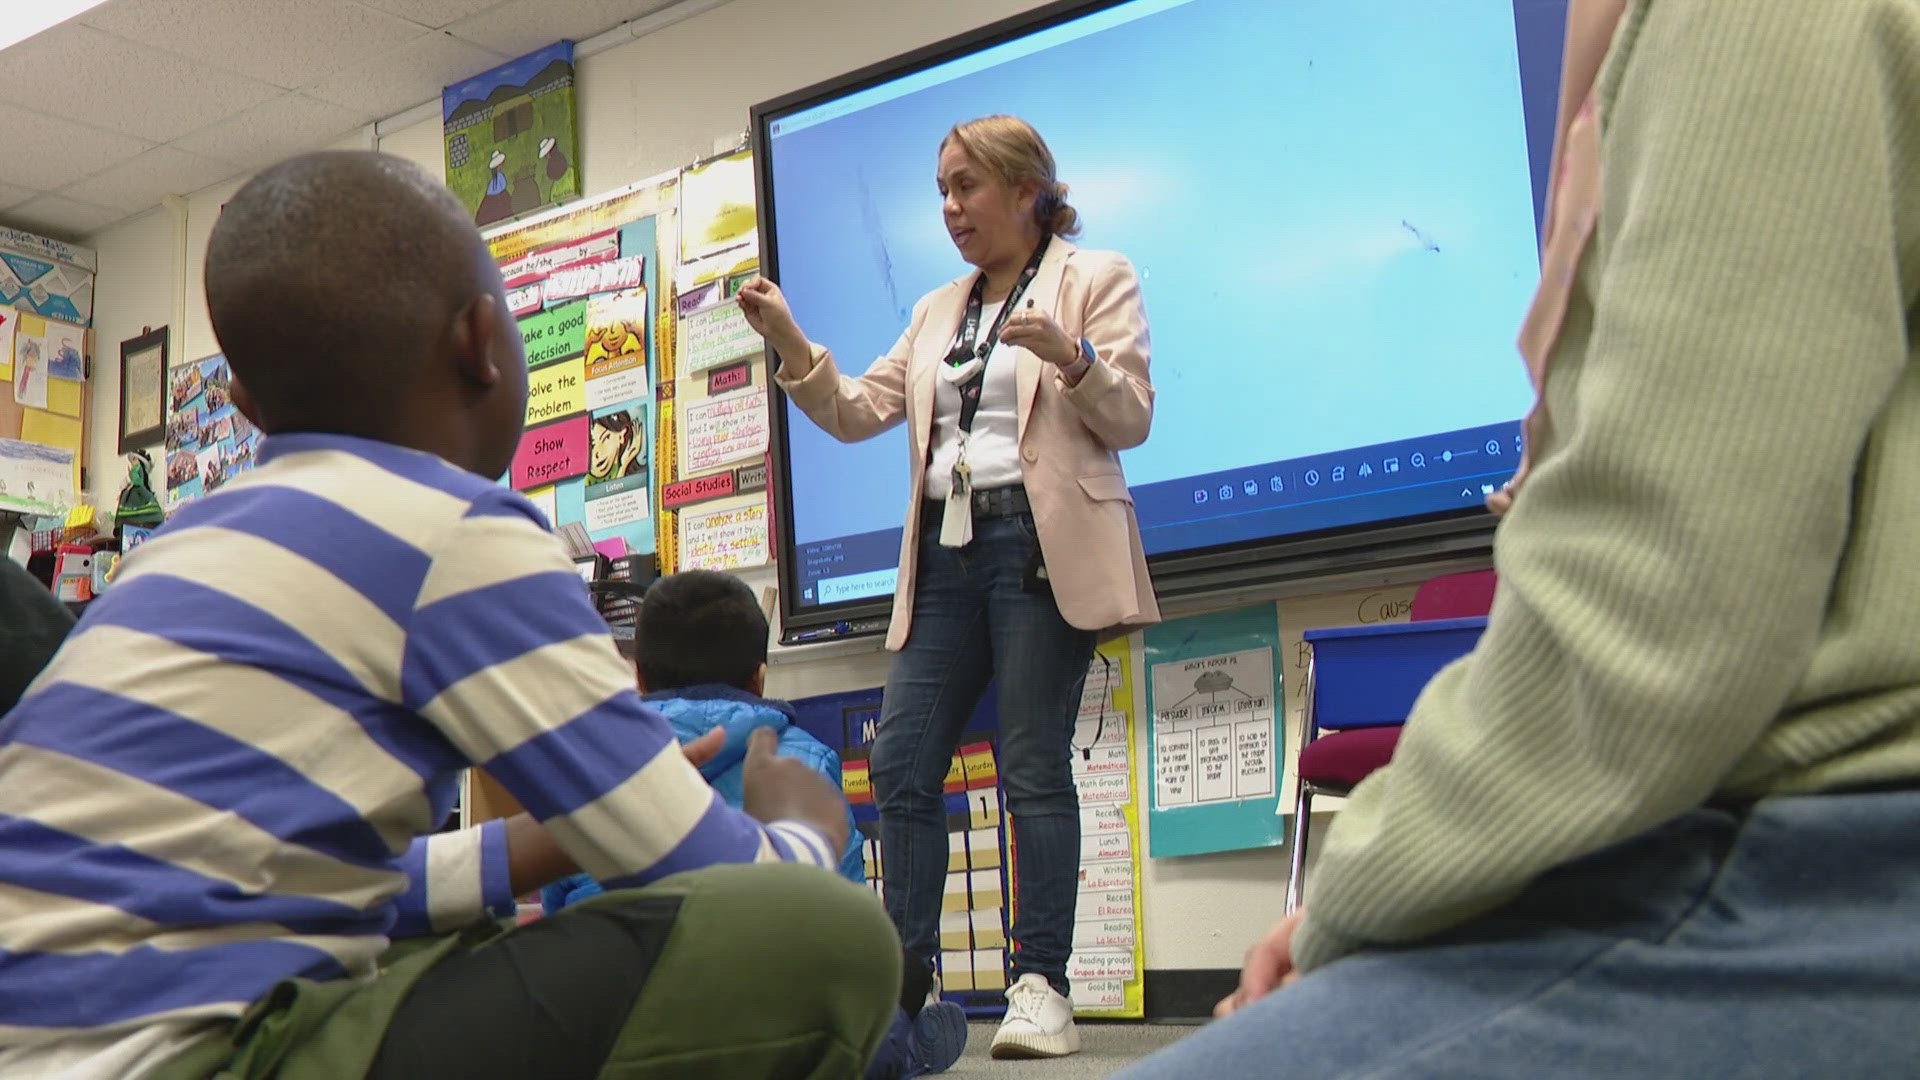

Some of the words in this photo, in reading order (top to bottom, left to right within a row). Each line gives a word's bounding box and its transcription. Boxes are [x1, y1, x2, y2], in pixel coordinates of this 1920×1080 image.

[579, 247, 588, 257] by
[524, 329, 542, 343] ake
[548, 324, 555, 335] a
[558, 311, 584, 336] good
[528, 341, 571, 365] decision
[558, 375, 576, 391] the
[714, 372, 741, 386] Math:
[528, 401, 572, 420] Problem
[722, 419, 738, 428] show
[747, 413, 756, 422] by
[534, 438, 564, 455] Show
[527, 457, 571, 479] Respect
[741, 470, 766, 485] Writi
[606, 482, 624, 492] Listen
[665, 484, 692, 500] Social
[695, 476, 731, 494] Studies
[693, 521, 705, 530] can
[720, 529, 735, 538] show
[836, 584, 850, 594] Type
[851, 582, 865, 591] here
[874, 578, 895, 587] search
[1108, 749, 1126, 759] Math
[967, 761, 993, 774] Saturday
[844, 777, 868, 788] Tuesday
[1080, 780, 1097, 788] Math
[1099, 778, 1124, 788] Groups
[980, 796, 987, 819] 1
[1099, 837, 1120, 846] Lunch
[1103, 866, 1132, 875] Writing
[1106, 894, 1131, 902] Recess
[1104, 923, 1132, 932] Reading
[1088, 981, 1105, 991] Good
[1107, 981, 1120, 991] Bye
